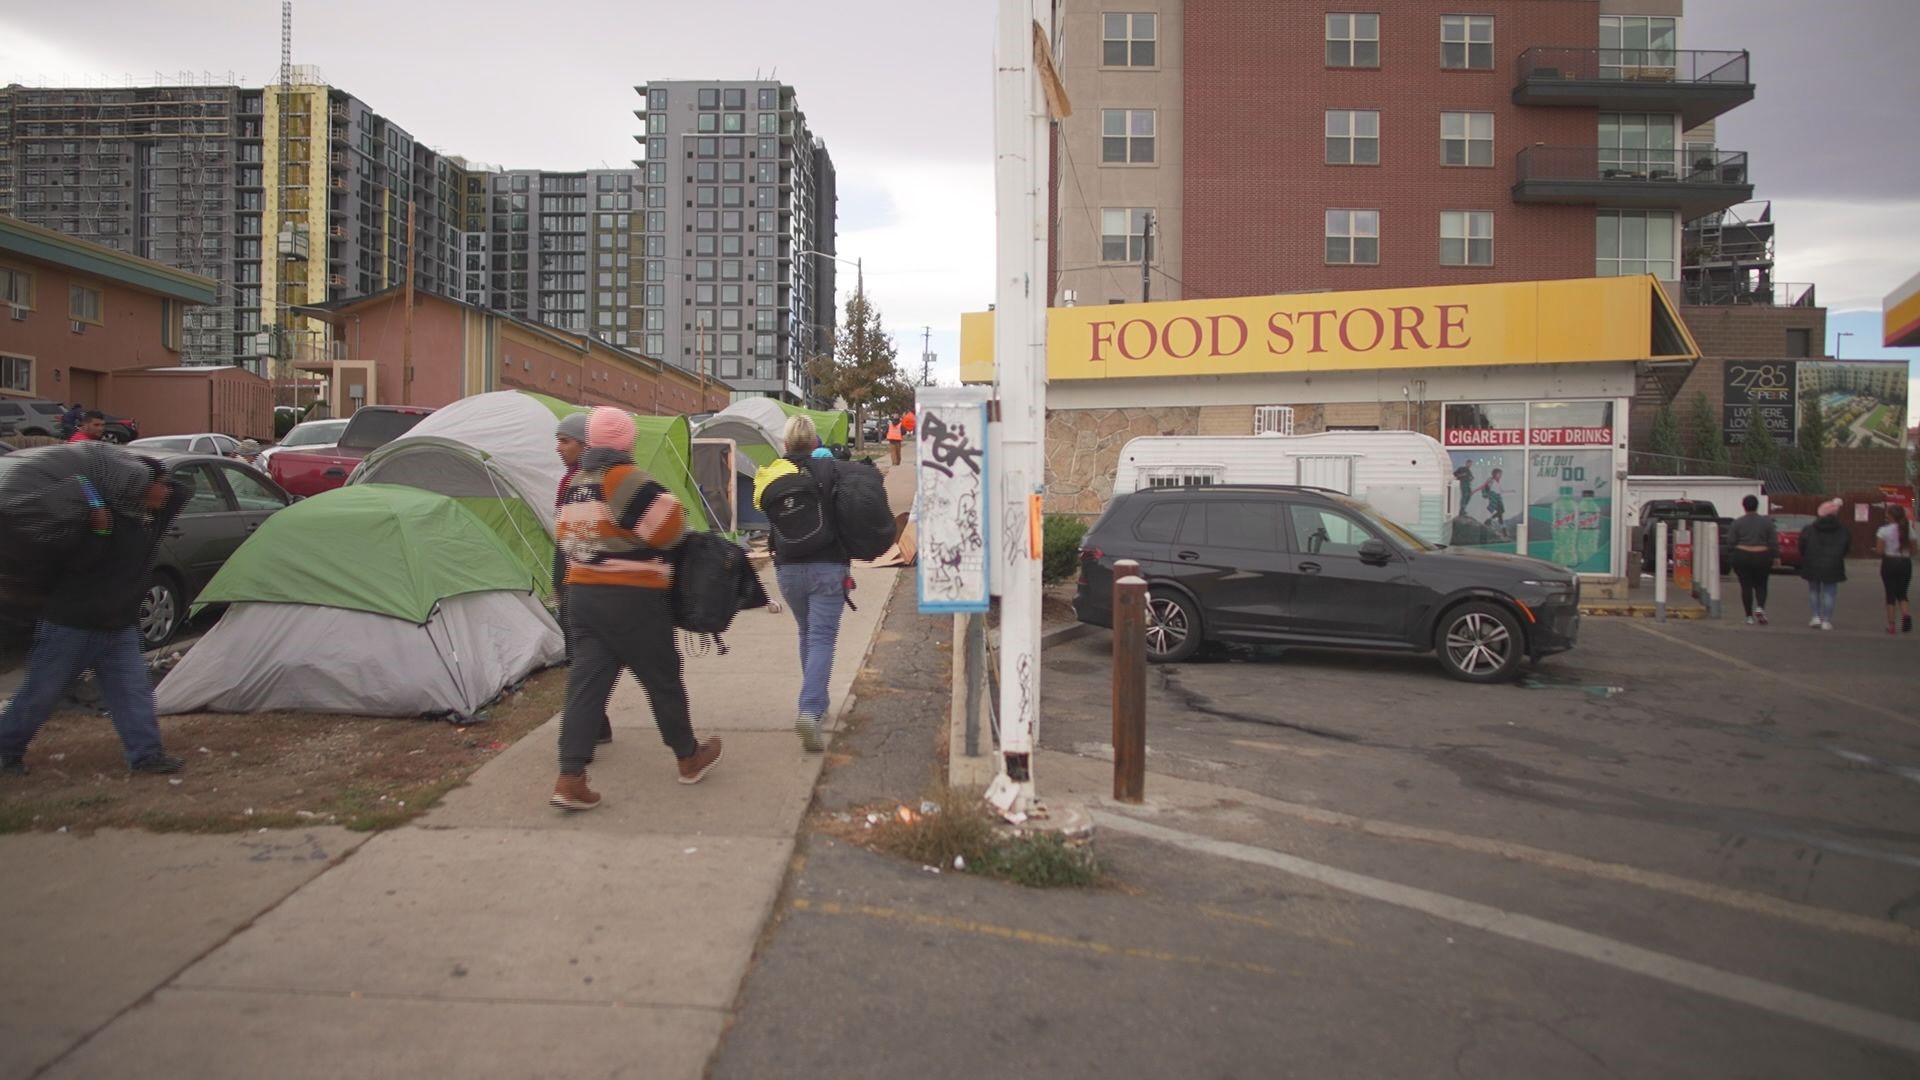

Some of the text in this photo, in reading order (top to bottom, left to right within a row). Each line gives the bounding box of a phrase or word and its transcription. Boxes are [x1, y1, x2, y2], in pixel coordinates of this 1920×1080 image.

[1088, 304, 1472, 362] FOOD STORE
[1729, 364, 1788, 393] 2785
[1449, 430, 1521, 444] CIGARETTE
[1531, 429, 1611, 443] SOFT DRINKS
[1532, 455, 1575, 467] GET OUT
[1536, 467, 1559, 478] AND
